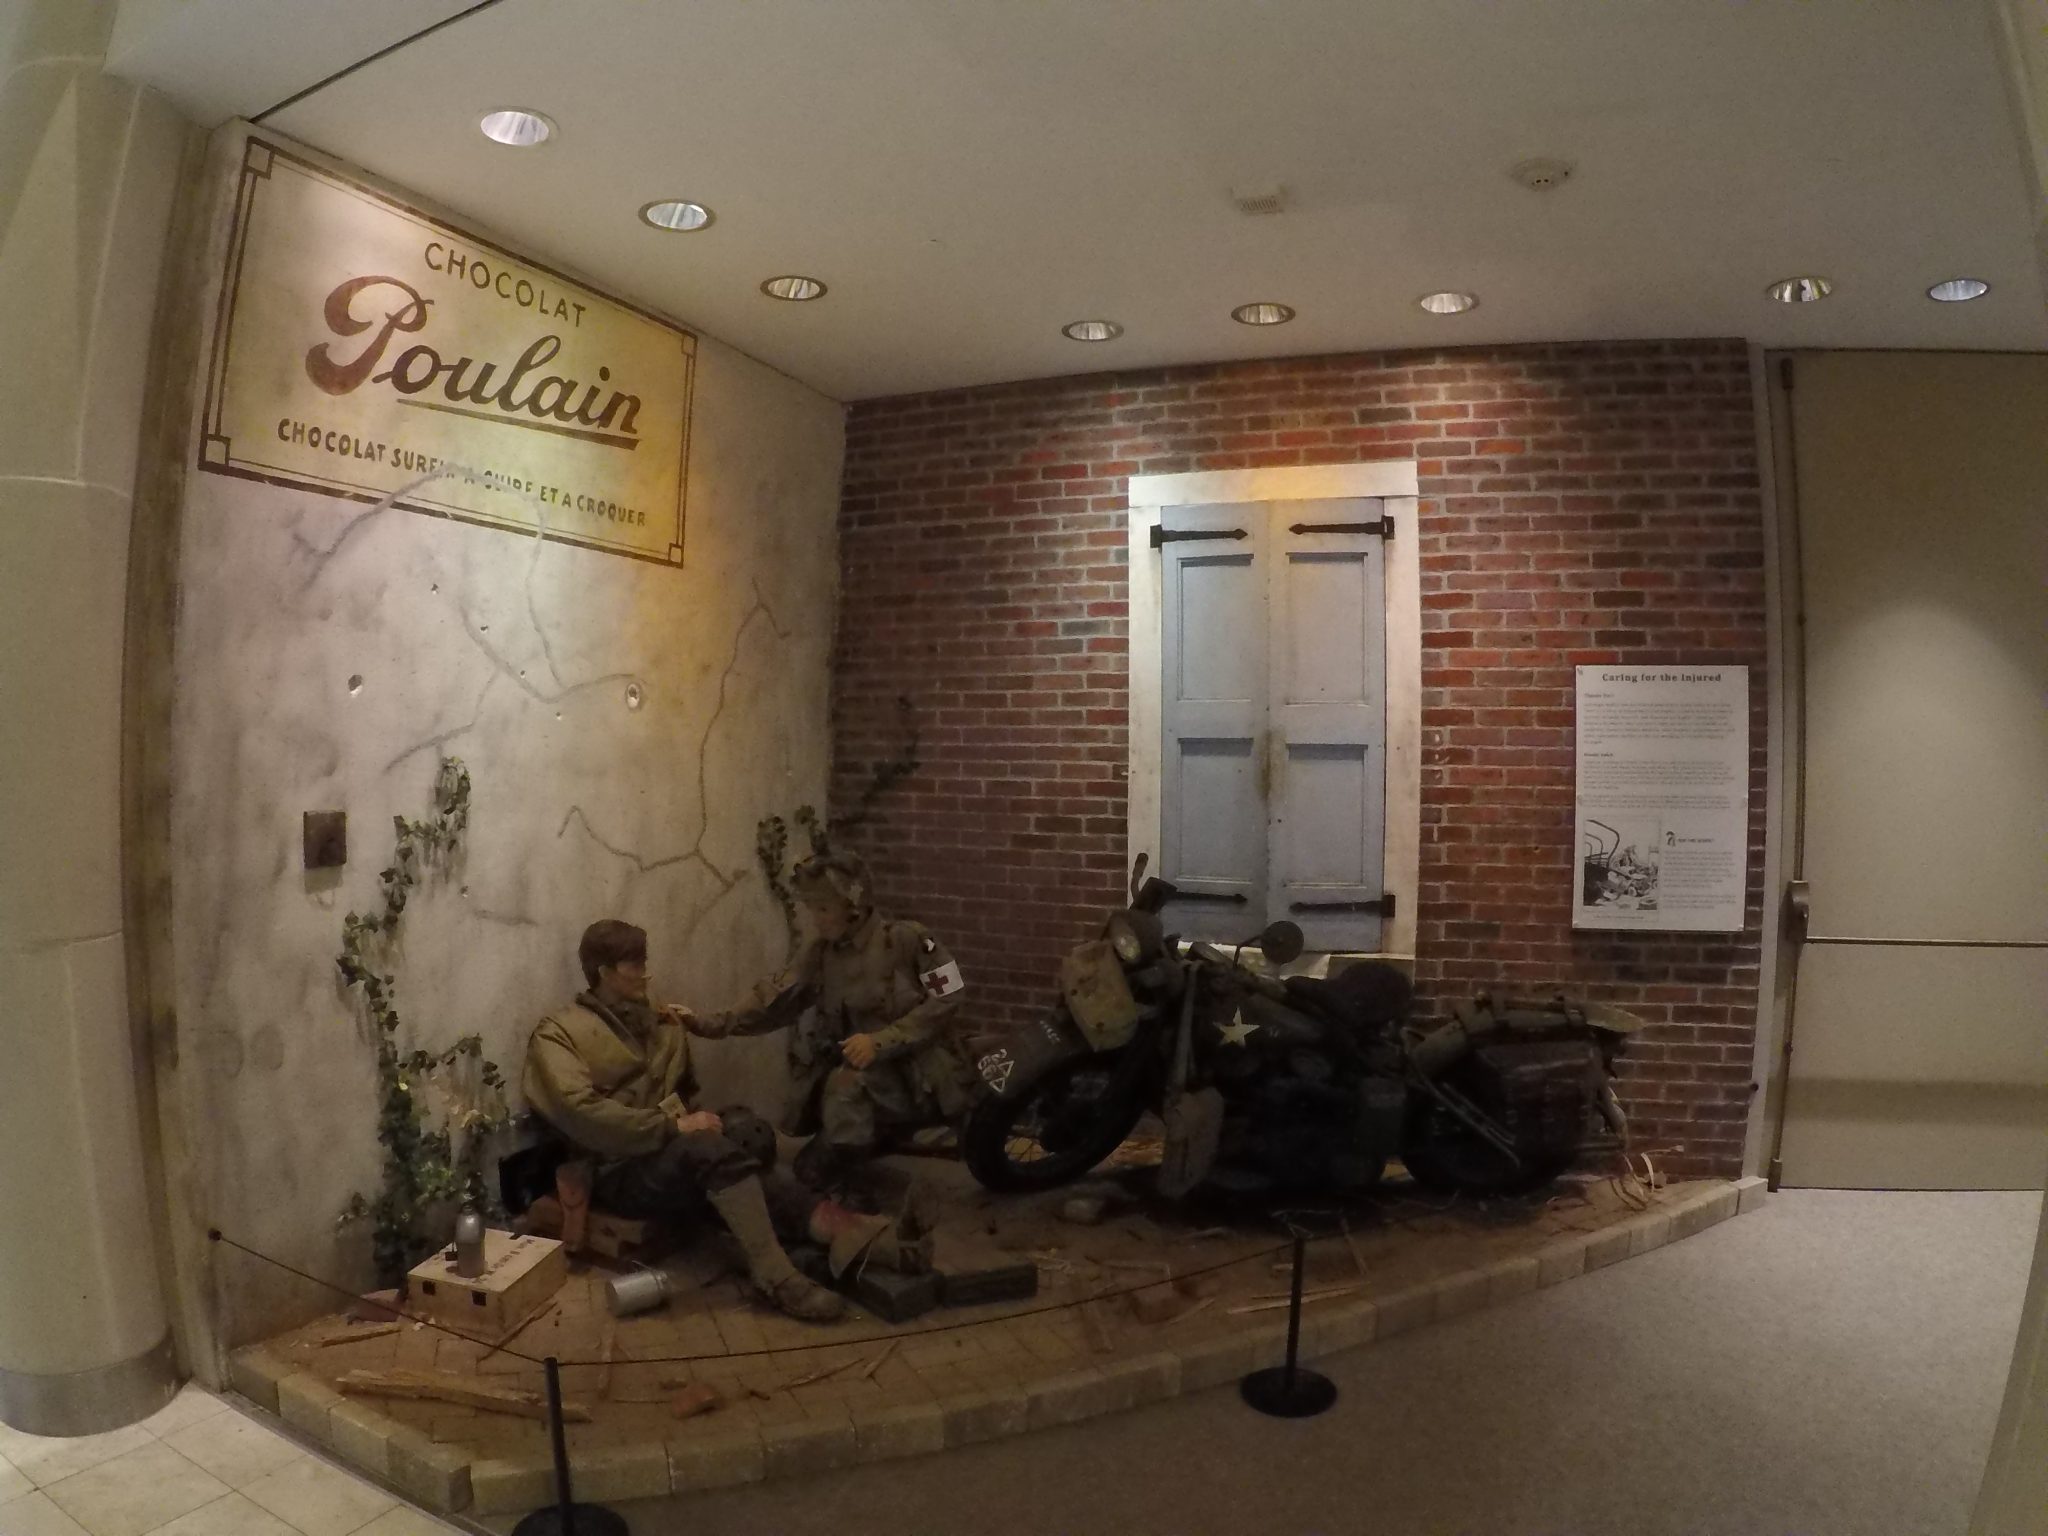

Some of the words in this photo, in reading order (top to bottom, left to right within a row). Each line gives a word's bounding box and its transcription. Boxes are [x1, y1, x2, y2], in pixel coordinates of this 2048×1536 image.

[424, 241, 586, 328] CHOCOLAT
[305, 275, 642, 435] Poulain
[278, 418, 386, 462] CHOCOLAT
[391, 448, 455, 479] SURF
[540, 485, 558, 504] ET
[562, 492, 572, 508] A
[576, 494, 645, 528] CROQUER
[1602, 673, 1638, 683] Caring
[1641, 673, 1657, 682] for
[1660, 673, 1678, 682] the
[1681, 673, 1721, 683] Injured
